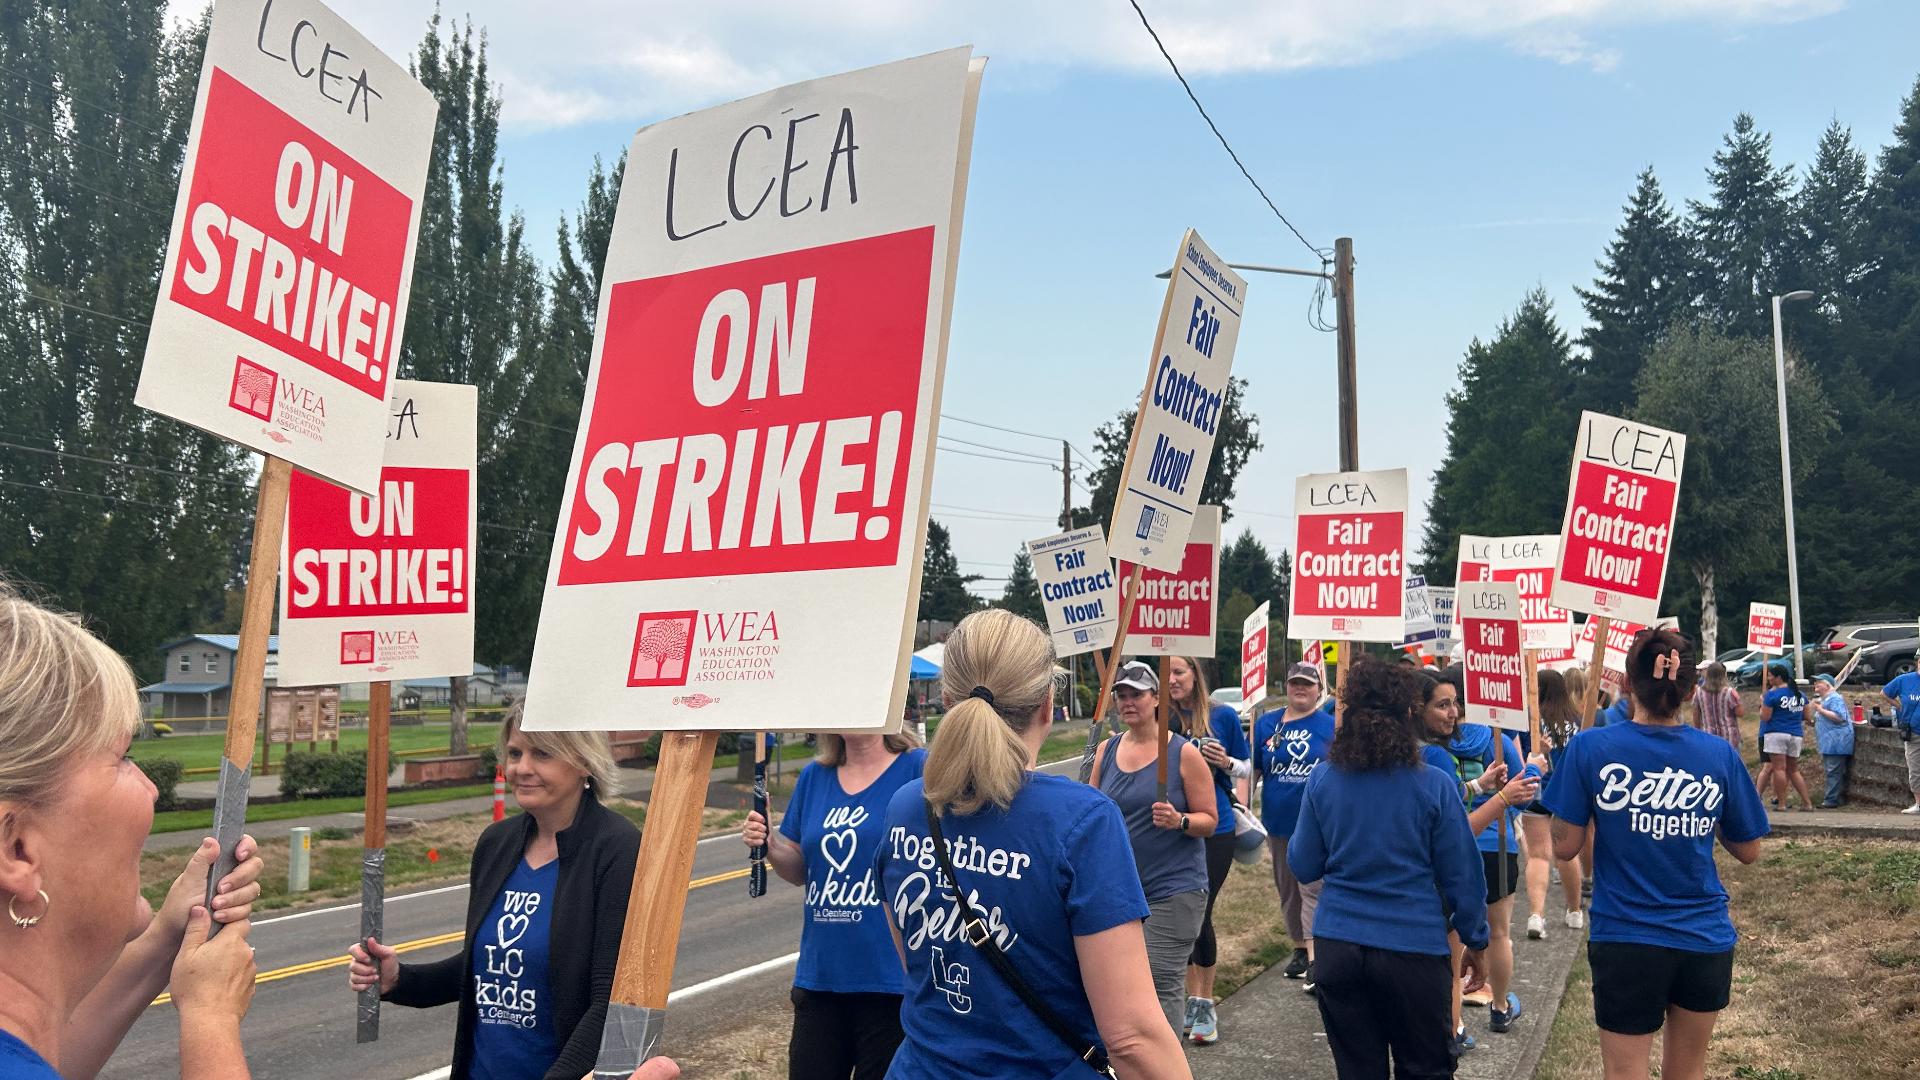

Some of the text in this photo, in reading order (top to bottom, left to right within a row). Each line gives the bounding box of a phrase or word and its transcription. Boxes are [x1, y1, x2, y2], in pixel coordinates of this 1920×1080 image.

[257, 0, 382, 123] LCEA
[665, 107, 859, 241] LCEA
[274, 141, 354, 256] ON
[183, 202, 392, 383] STRIKE!
[1187, 294, 1220, 360] Fair
[692, 277, 816, 407] ON
[281, 378, 325, 417] WEA
[1153, 354, 1222, 438] Contract
[278, 401, 326, 427] WASHINGTON
[280, 411, 322, 433] EDUCATION
[276, 419, 323, 443] ASSOCIATION
[1586, 420, 1677, 477] LCEA
[1147, 433, 1194, 496] Now!
[572, 410, 903, 562] STRIKE!
[1311, 484, 1376, 506] LCEA
[1603, 474, 1647, 512] Fair
[349, 481, 414, 537] ON
[1328, 518, 1373, 545] Fair
[1572, 506, 1667, 554] Contract
[1055, 549, 1086, 572] Fair
[1299, 549, 1401, 577] Contract
[1472, 544, 1490, 559] LC
[1501, 542, 1543, 559] LCEA
[293, 547, 464, 608] STRIKE!
[1585, 547, 1641, 587] Now!
[1043, 569, 1113, 602] Contract
[1318, 582, 1377, 609] Now!
[1515, 572, 1542, 595] ON
[1063, 599, 1105, 625] Now!
[1435, 597, 1454, 609] Fair
[1473, 592, 1507, 610] LCEA
[703, 610, 779, 643] WEA
[1139, 605, 1190, 629] Now!
[1760, 617, 1775, 626] Fair
[378, 630, 419, 645] WEA
[1480, 623, 1504, 647] Fair
[1751, 626, 1782, 637] Contract
[1757, 636, 1776, 645] Now!
[699, 645, 780, 657] WASHINGTON
[702, 658, 772, 669] EDUCATION
[1466, 649, 1521, 676] Contract
[694, 670, 775, 682] ASSOCIATION
[1480, 677, 1511, 703] Now!
[1285, 729, 1312, 740] we
[1285, 757, 1320, 776] kid
[1596, 763, 1723, 811] Better
[823, 806, 869, 829] we
[1629, 808, 1717, 840] Together
[890, 827, 1031, 879] Togther
[504, 890, 541, 915] we
[822, 908, 852, 918] Center
[484, 944, 523, 978] LC
[475, 975, 536, 1012] kids
[931, 946, 972, 1014] LC
